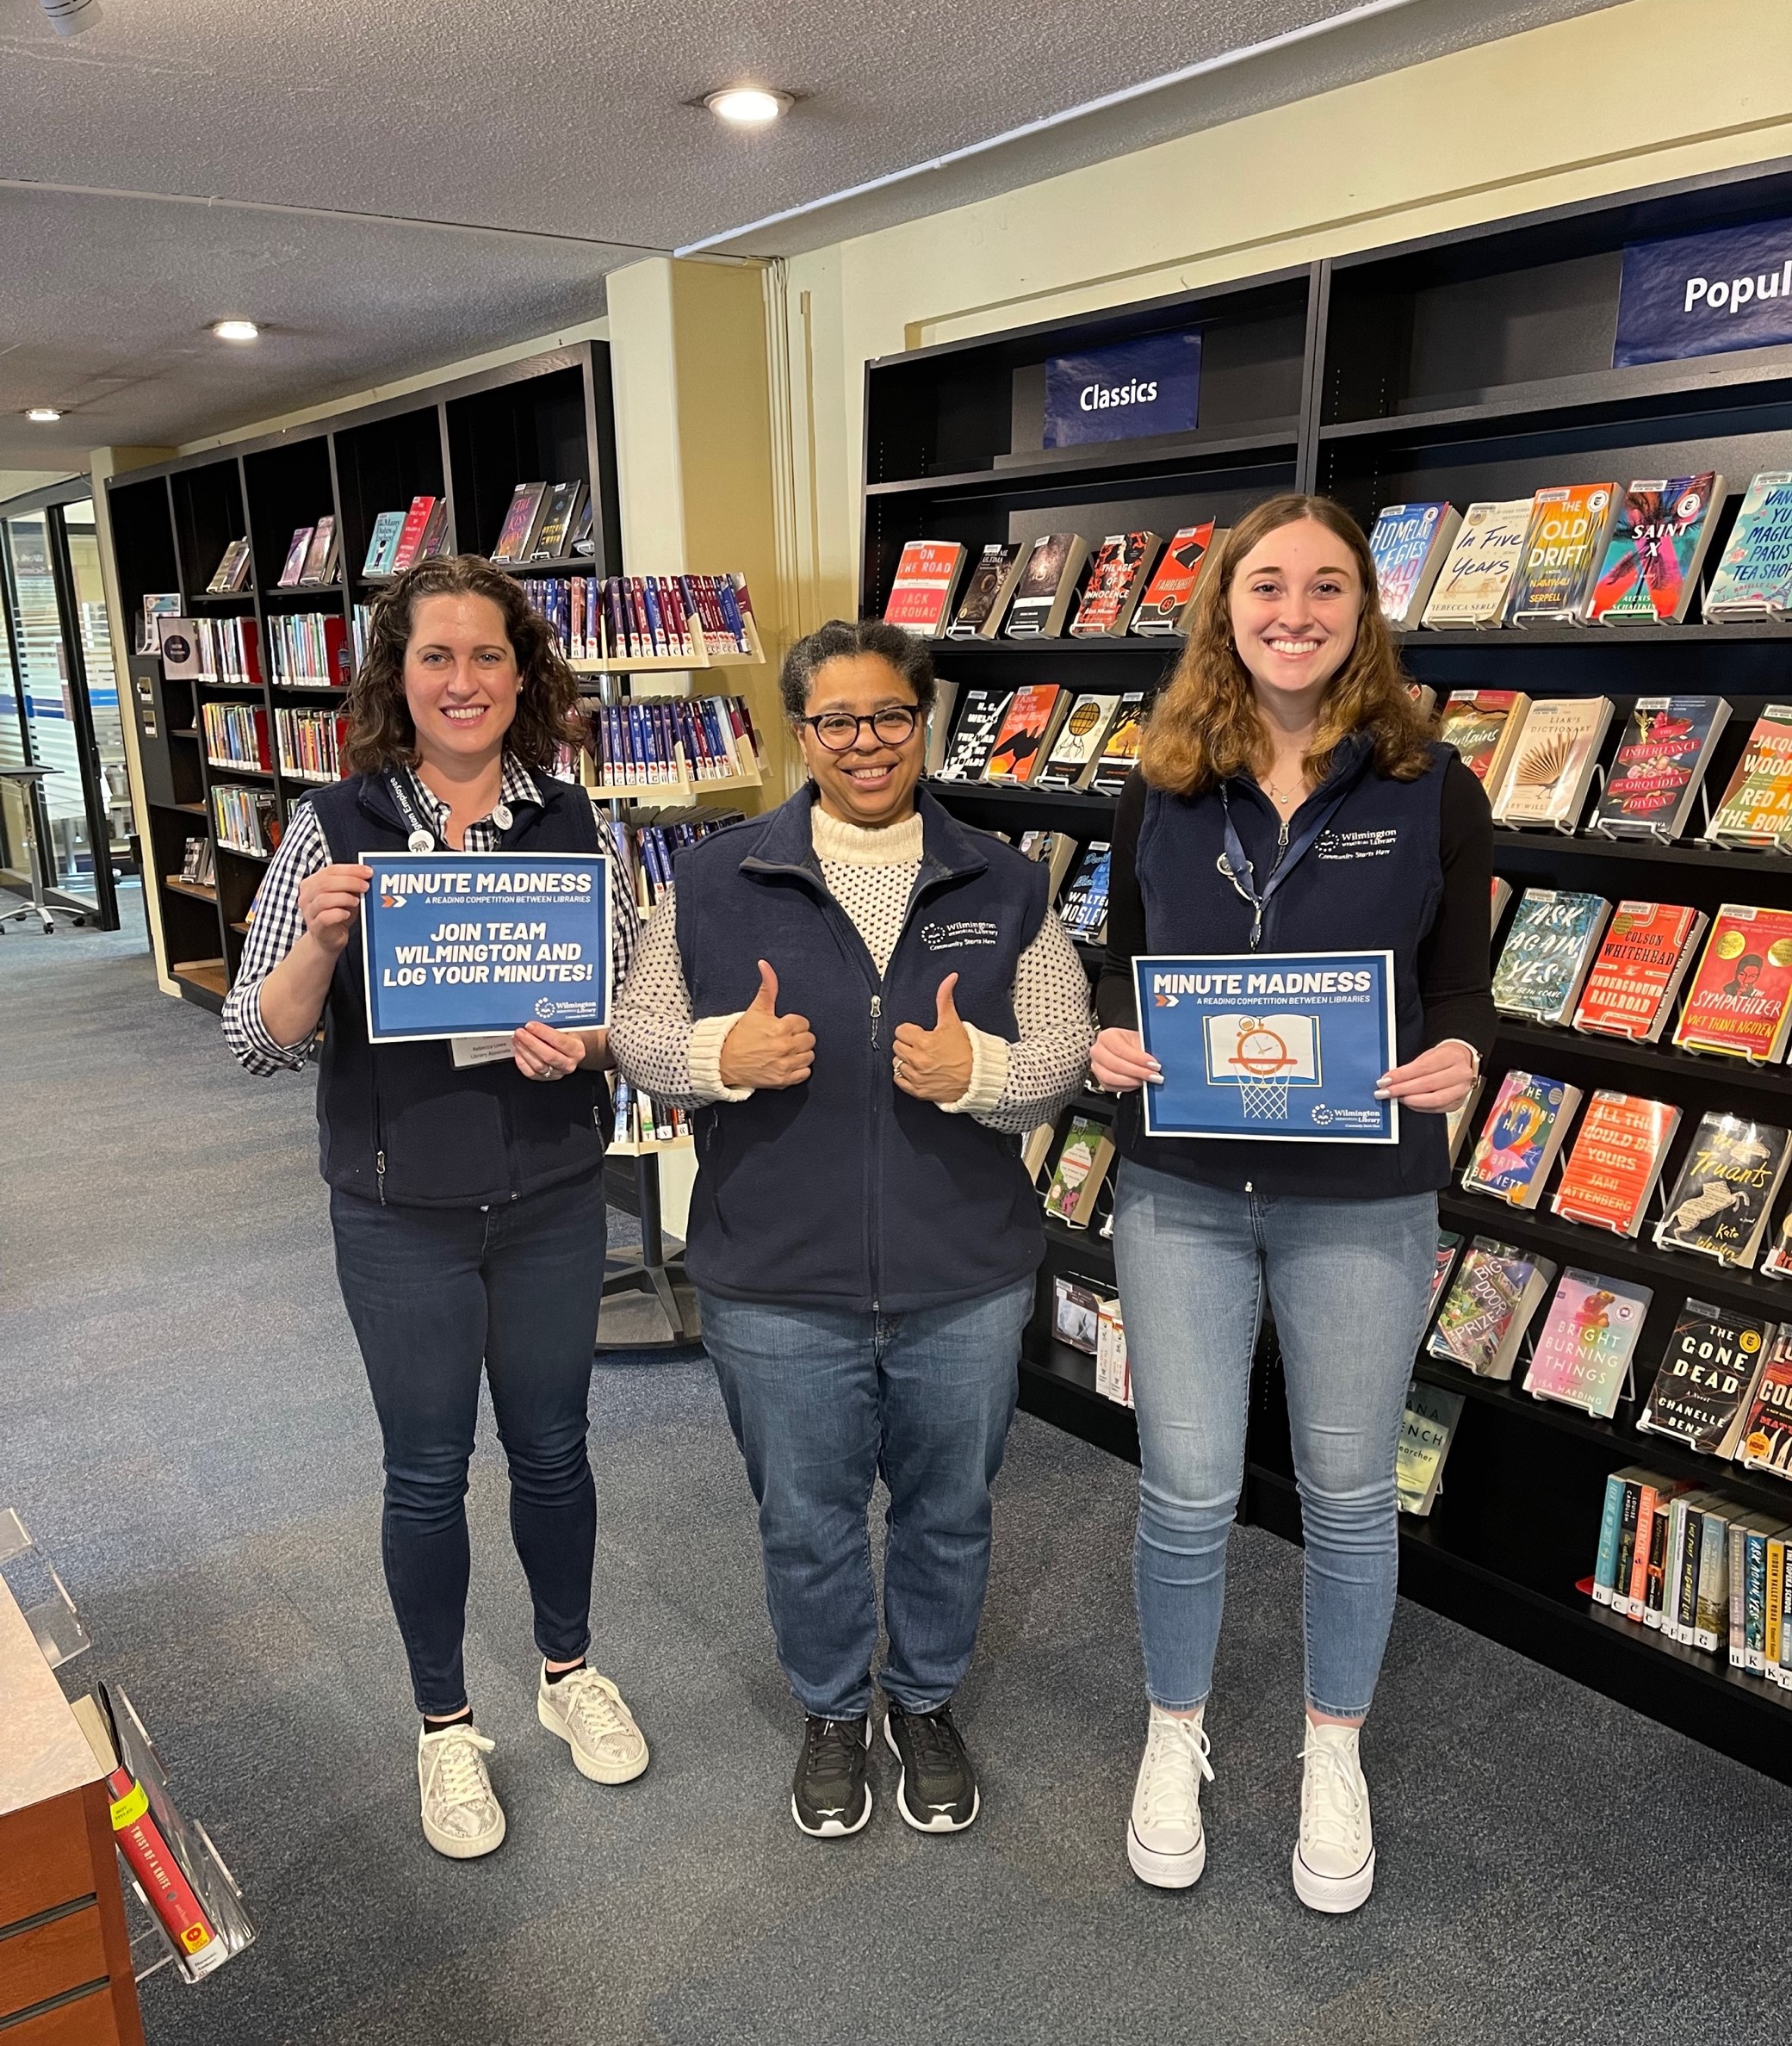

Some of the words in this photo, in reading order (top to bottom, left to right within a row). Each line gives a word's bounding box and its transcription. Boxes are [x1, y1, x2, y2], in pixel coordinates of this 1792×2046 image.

[1683, 260, 1792, 314] Popul
[1080, 378, 1157, 412] Classics
[1561, 501, 1582, 512] THE
[1456, 528, 1476, 550] In
[1479, 525, 1522, 549] Five
[1542, 518, 1589, 541] OLD
[1632, 522, 1689, 539] SAINT
[920, 549, 935, 560] ON
[1528, 545, 1588, 567] DRIFT
[1646, 542, 1662, 557] X
[1749, 543, 1792, 562] PARIS
[921, 562, 951, 574] ROAD
[1102, 563, 1116, 573] THE
[1118, 562, 1133, 572] AGE
[1446, 556, 1510, 592] Years
[1733, 565, 1758, 581] TEA
[1106, 576, 1119, 586] OF
[1155, 575, 1194, 592] FAHRENHEIT
[1529, 578, 1570, 587] NAMWALI
[901, 593, 929, 604] JACK
[1084, 590, 1130, 599] INNOCENCE
[1529, 593, 1561, 602] SERPELL
[1161, 599, 1172, 611] 451
[1626, 741, 1698, 757] INHERITANCE
[1625, 777, 1683, 789] ORQUÍDEA
[390, 777, 412, 814] Employee
[1629, 797, 1667, 809] DIVINA
[1739, 788, 1776, 808] RED
[1718, 809, 1751, 828] THE
[1342, 829, 1397, 840] Wilmington
[1370, 837, 1398, 846] Library
[380, 873, 472, 895] MINUTE
[475, 873, 592, 895] MADNESS
[432, 896, 465, 904] READING
[466, 896, 515, 904] COMPETITION
[1060, 902, 1108, 927] MOSLEY
[1526, 902, 1584, 927] ASK
[430, 923, 481, 942] JOIN
[487, 921, 547, 941] TEAM
[946, 921, 997, 931] Wilmington
[975, 927, 998, 937] Library
[930, 941, 963, 951] Community
[1504, 932, 1585, 959] AGAIN,
[1625, 931, 1664, 946] COLSON
[394, 944, 532, 964] WILMINGTON
[536, 943, 582, 961] AND
[1603, 944, 1675, 966] WHITEHEAD
[383, 967, 427, 988] LOG
[432, 965, 490, 984] YOUR
[493, 964, 593, 983] MINUTES!
[1507, 959, 1559, 984] YES
[1153, 974, 1243, 995] MINUTE
[1246, 971, 1372, 994] MADNESS
[1590, 974, 1665, 999] UNDERGROUND
[1751, 989, 1765, 997] THE
[1203, 997, 1236, 1006] READING
[1237, 997, 1288, 1006] COMPETITION
[1289, 996, 1327, 1005] BETWEEN
[1329, 995, 1371, 1004] LIBRARIES
[1590, 989, 1651, 1013] RAILROAD
[1692, 990, 1782, 1017] SYMPATHIZER
[1687, 1014, 1706, 1025] VIET
[1708, 1017, 1736, 1032] THANH
[1738, 1021, 1777, 1038] NGUYEN
[1522, 1086, 1543, 1100] THE
[1334, 1110, 1380, 1119] Wilmington
[1594, 1105, 1621, 1123] ALL
[1503, 1119, 1531, 1135] HALF
[1584, 1125, 1634, 1147] COULD
[1713, 1132, 1733, 1149] the
[1491, 1155, 1517, 1171] BRIT
[1588, 1147, 1637, 1171] YOURS
[1472, 1166, 1523, 1192] BENNETT
[1690, 1151, 1772, 1188] Truants
[1587, 1175, 1619, 1191] JAMI
[1563, 1186, 1633, 1212] ATTENBERG
[1715, 1224, 1739, 1239] Kate
[1474, 1261, 1503, 1280] BIG
[1476, 1282, 1507, 1315] DOOR
[1454, 1311, 1499, 1340] PRIZE
[1558, 1321, 1621, 1348] BRIGHT
[1709, 1324, 1735, 1341] THE
[1545, 1336, 1619, 1367] BURNING
[1681, 1336, 1750, 1372] GONE
[1544, 1355, 1607, 1385] THINGS
[1672, 1359, 1739, 1394] DEAD
[1534, 1378, 1553, 1389] LISA
[1557, 1386, 1603, 1404] HARDING
[1658, 1397, 1725, 1428] CHANELLE
[1668, 1416, 1704, 1436] BENZ
[1748, 1440, 1764, 1450] HBO
[1624, 1491, 1633, 1522] CANDLISH
[1642, 1491, 1652, 1516] TRUST
[1636, 1518, 1649, 1555] EXERCISE
[1751, 1540, 1762, 1563] ASK
[1683, 1575, 1693, 1603] GUEST
[1749, 1564, 1760, 1596] AGAIN,
[1770, 1578, 1779, 1603] VALLEY
[1682, 1603, 1690, 1621] LIST
[1749, 1596, 1760, 1620] YES
[1749, 1656, 1758, 1666] K
[1768, 1669, 1776, 1677] K
[130, 1826, 149, 1851] TWIST
[144, 1849, 155, 1863] OF
[152, 1868, 171, 1891] KNIFE
[189, 1930, 199, 1939] 14
